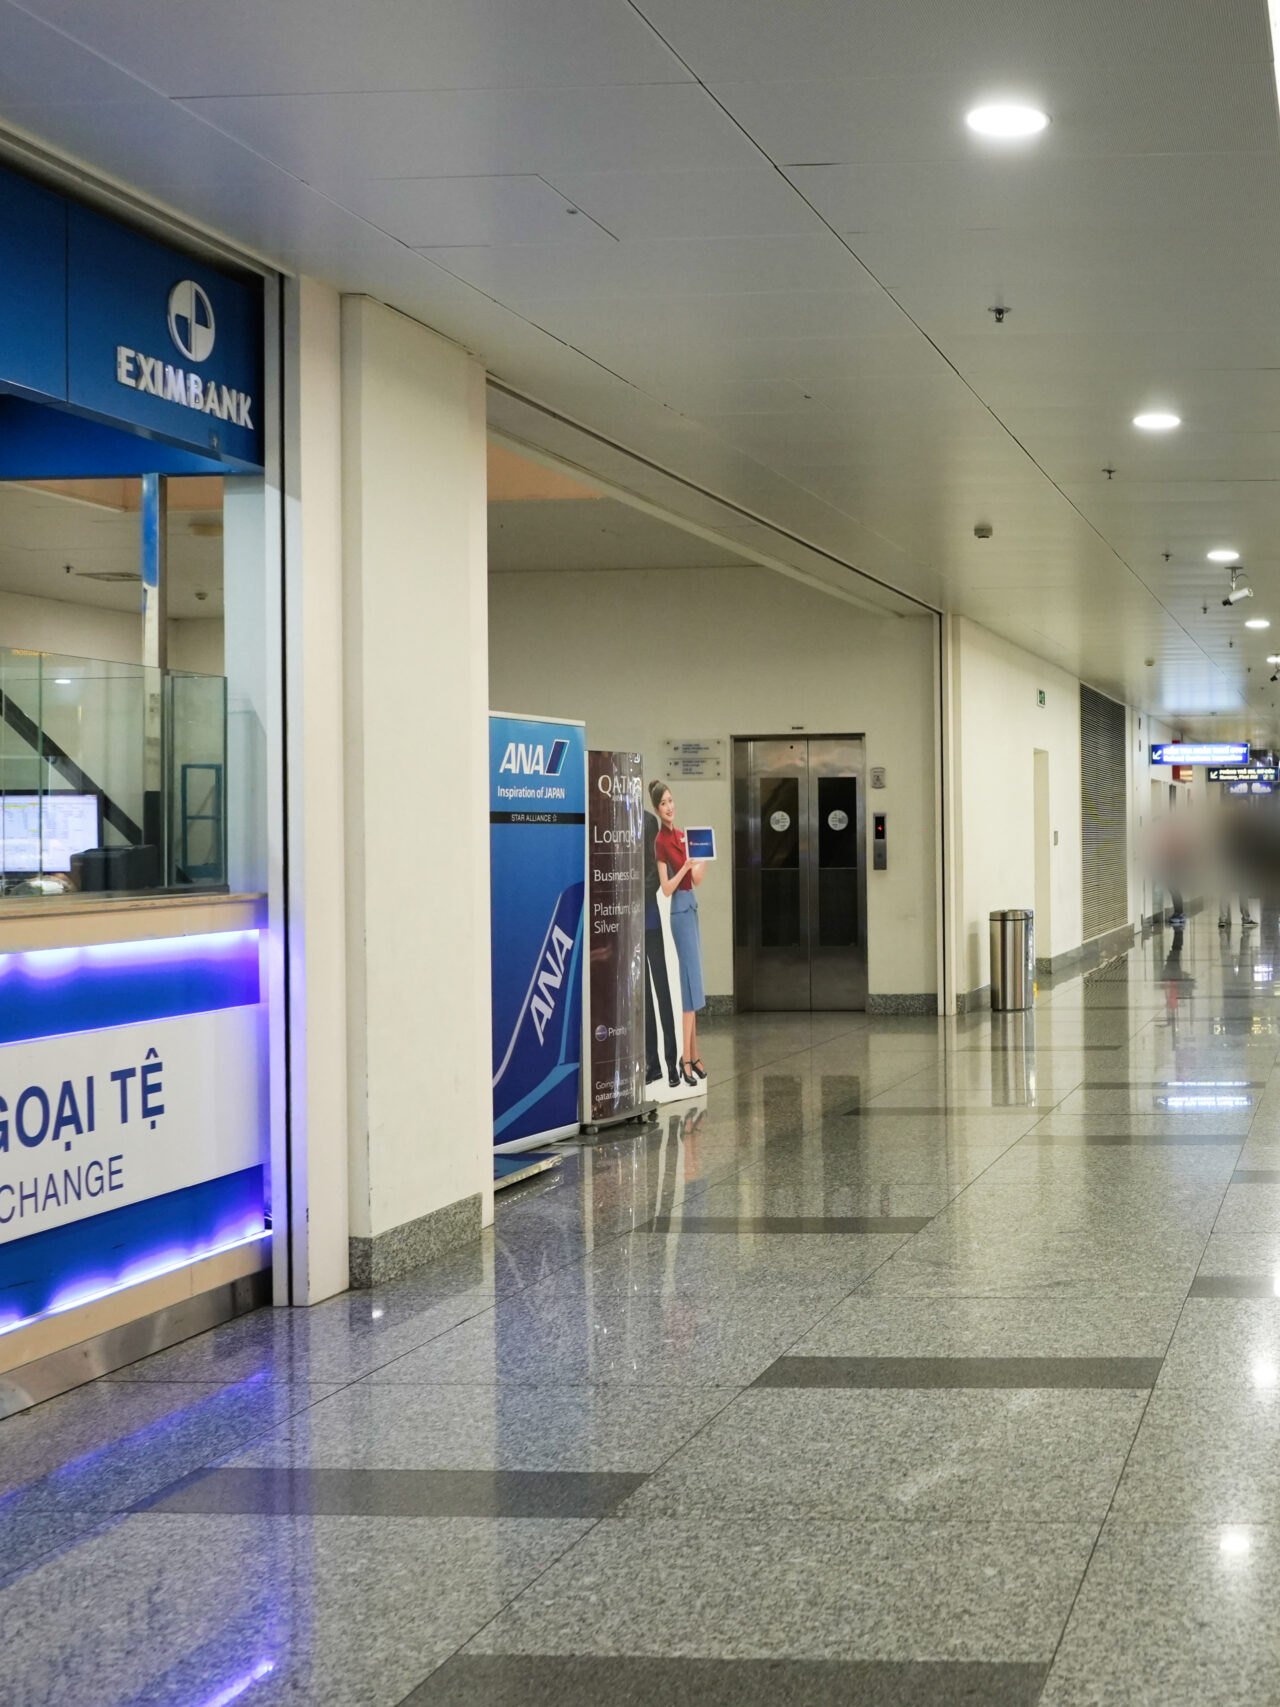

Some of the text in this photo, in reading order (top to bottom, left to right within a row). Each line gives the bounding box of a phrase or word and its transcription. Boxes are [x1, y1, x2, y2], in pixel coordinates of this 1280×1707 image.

[117, 345, 255, 430] EXIMBANK
[499, 742, 545, 775] ANA
[497, 786, 565, 800] Inspiration of JAPAN
[511, 813, 551, 822] STAR ALLIANCE
[593, 869, 630, 882] Business
[594, 919, 619, 934] Silver
[530, 924, 574, 1046] ANA
[110, 1047, 165, 1130] TỆ
[0, 1154, 124, 1224] CHANGE
